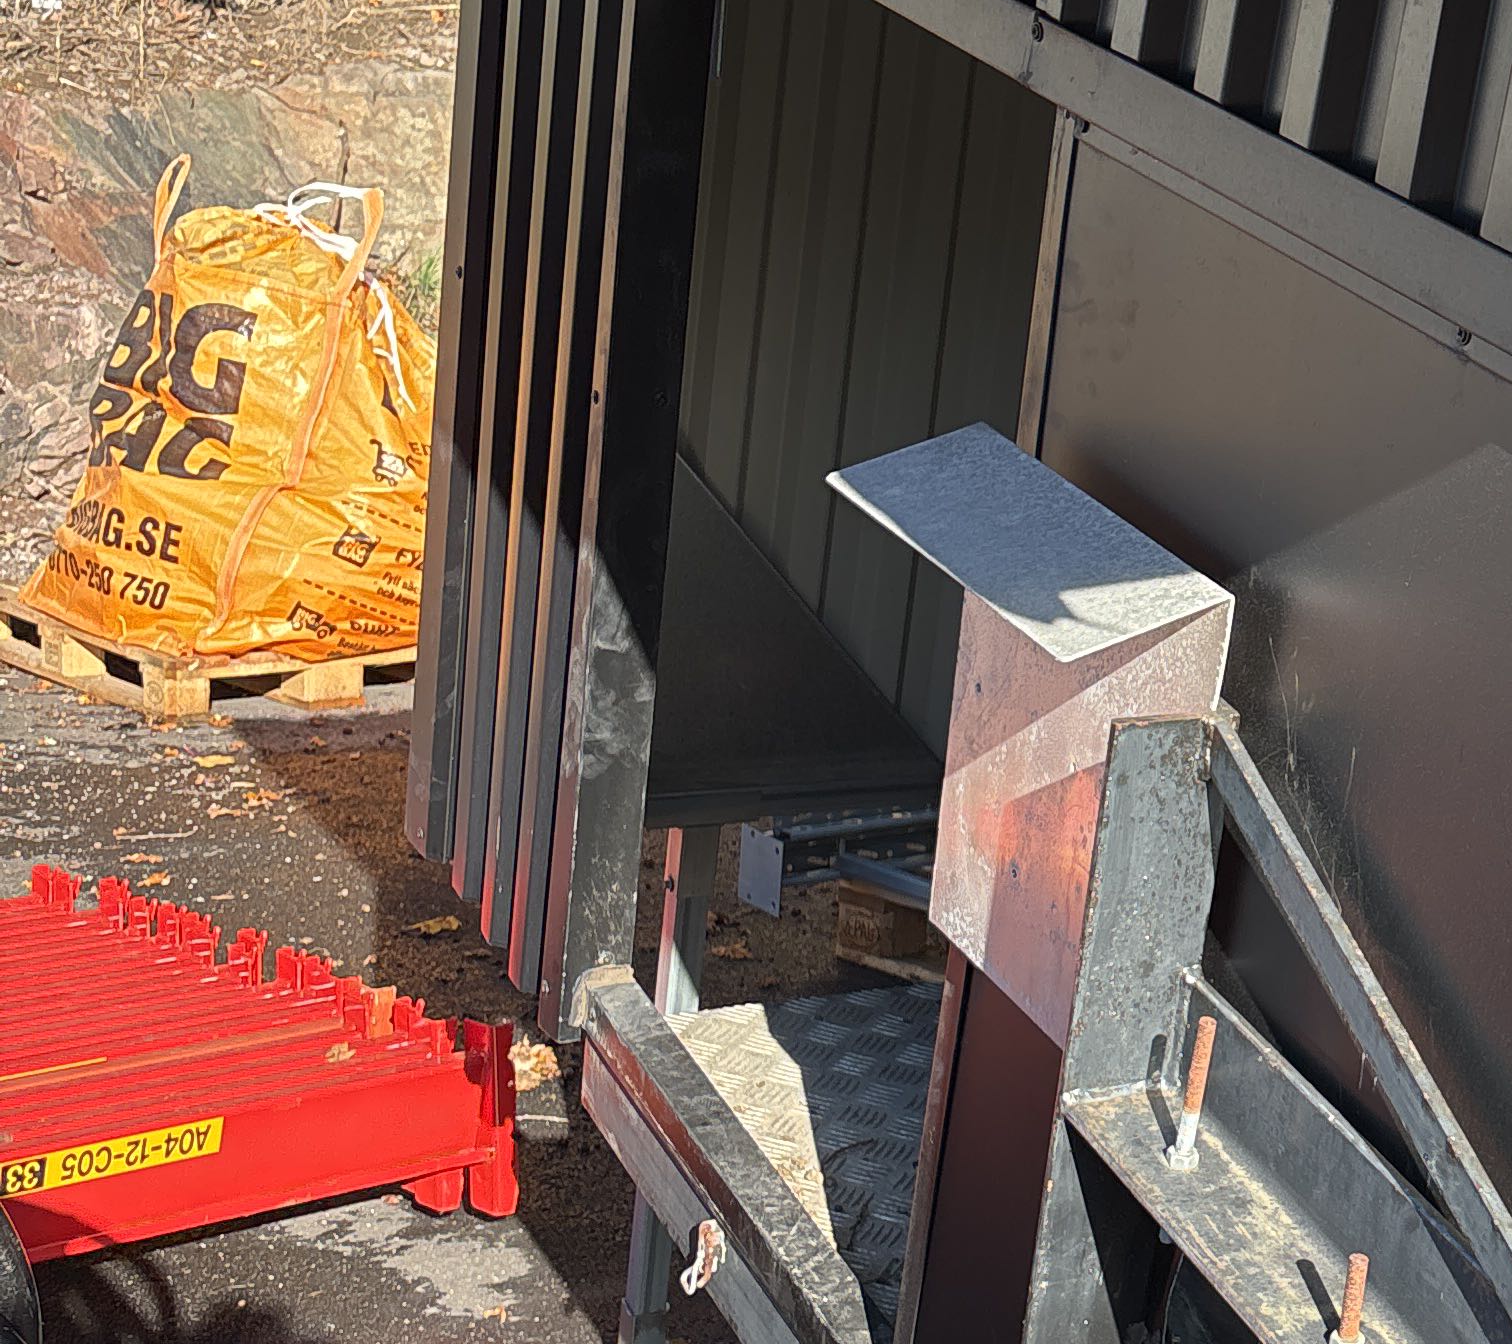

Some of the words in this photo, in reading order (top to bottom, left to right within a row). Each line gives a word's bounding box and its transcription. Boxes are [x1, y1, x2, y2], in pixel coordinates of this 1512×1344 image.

[103, 289, 258, 415] BIG
[120, 571, 170, 610] 750
[60, 1123, 212, 1181] A04-12-C05
[5, 1160, 41, 1194] 33
